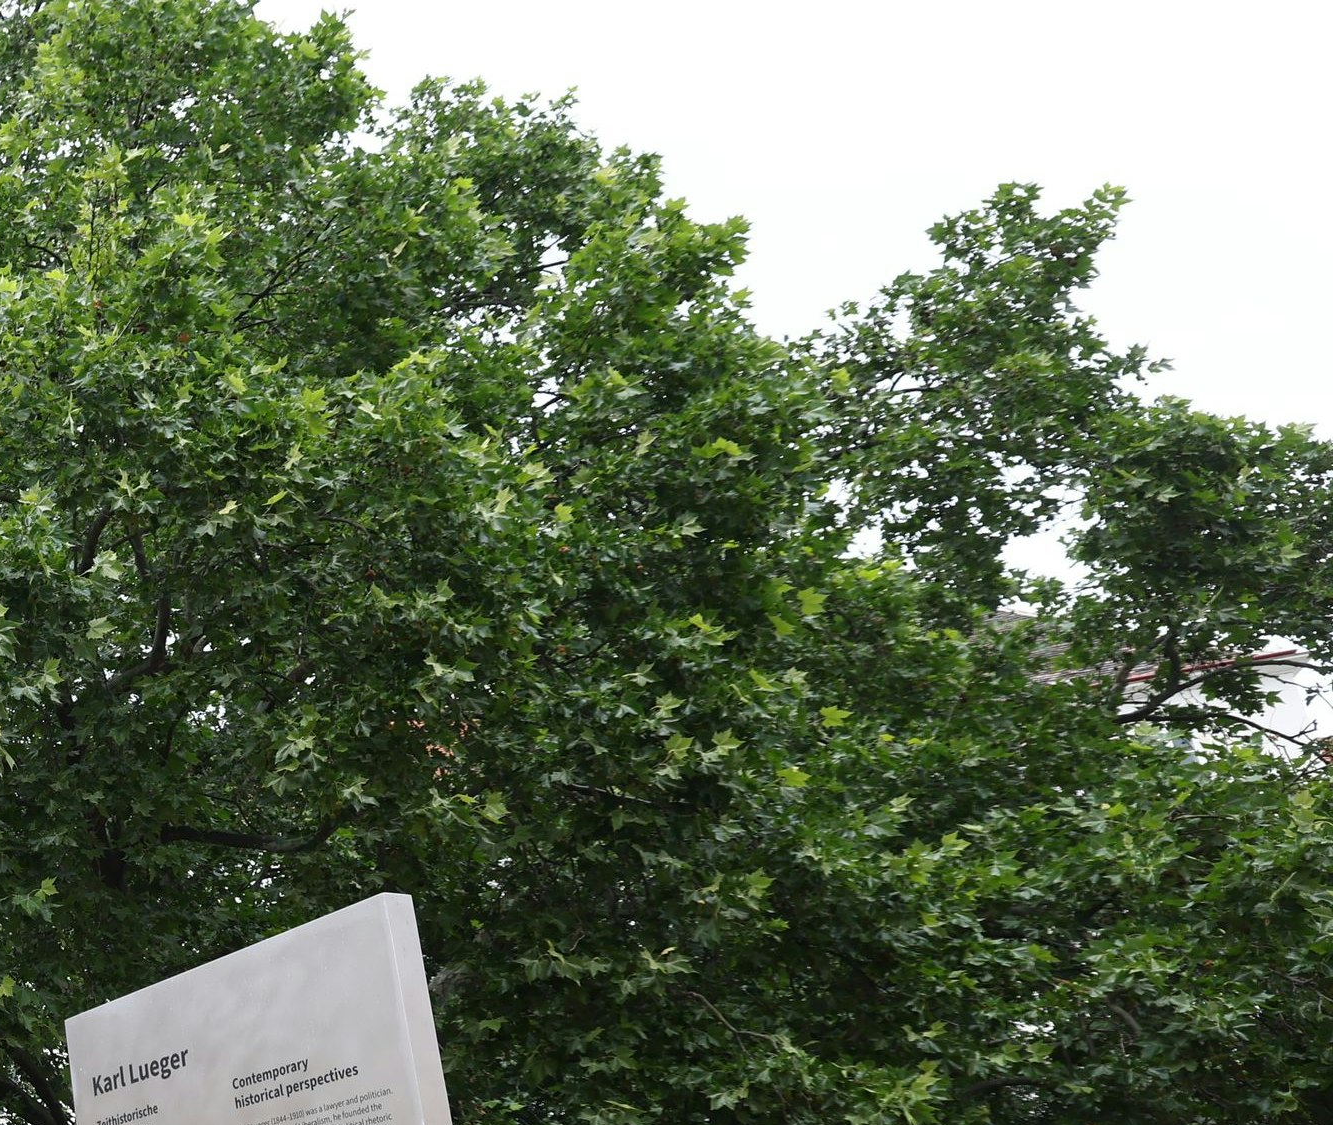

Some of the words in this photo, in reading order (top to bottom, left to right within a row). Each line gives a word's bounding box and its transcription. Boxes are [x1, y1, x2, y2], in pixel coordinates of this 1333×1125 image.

[92, 1065, 126, 1097] Karl
[129, 1048, 189, 1085] Lueger
[232, 1058, 309, 1090] Contemporary
[234, 1084, 284, 1109] historical
[286, 1065, 359, 1096] perspectives
[305, 1108, 318, 1116] was
[323, 1101, 345, 1113] lawyer
[346, 1095, 358, 1106] and
[332, 1112, 342, 1122] he
[342, 1104, 370, 1119] founded
[370, 1102, 382, 1112] the
